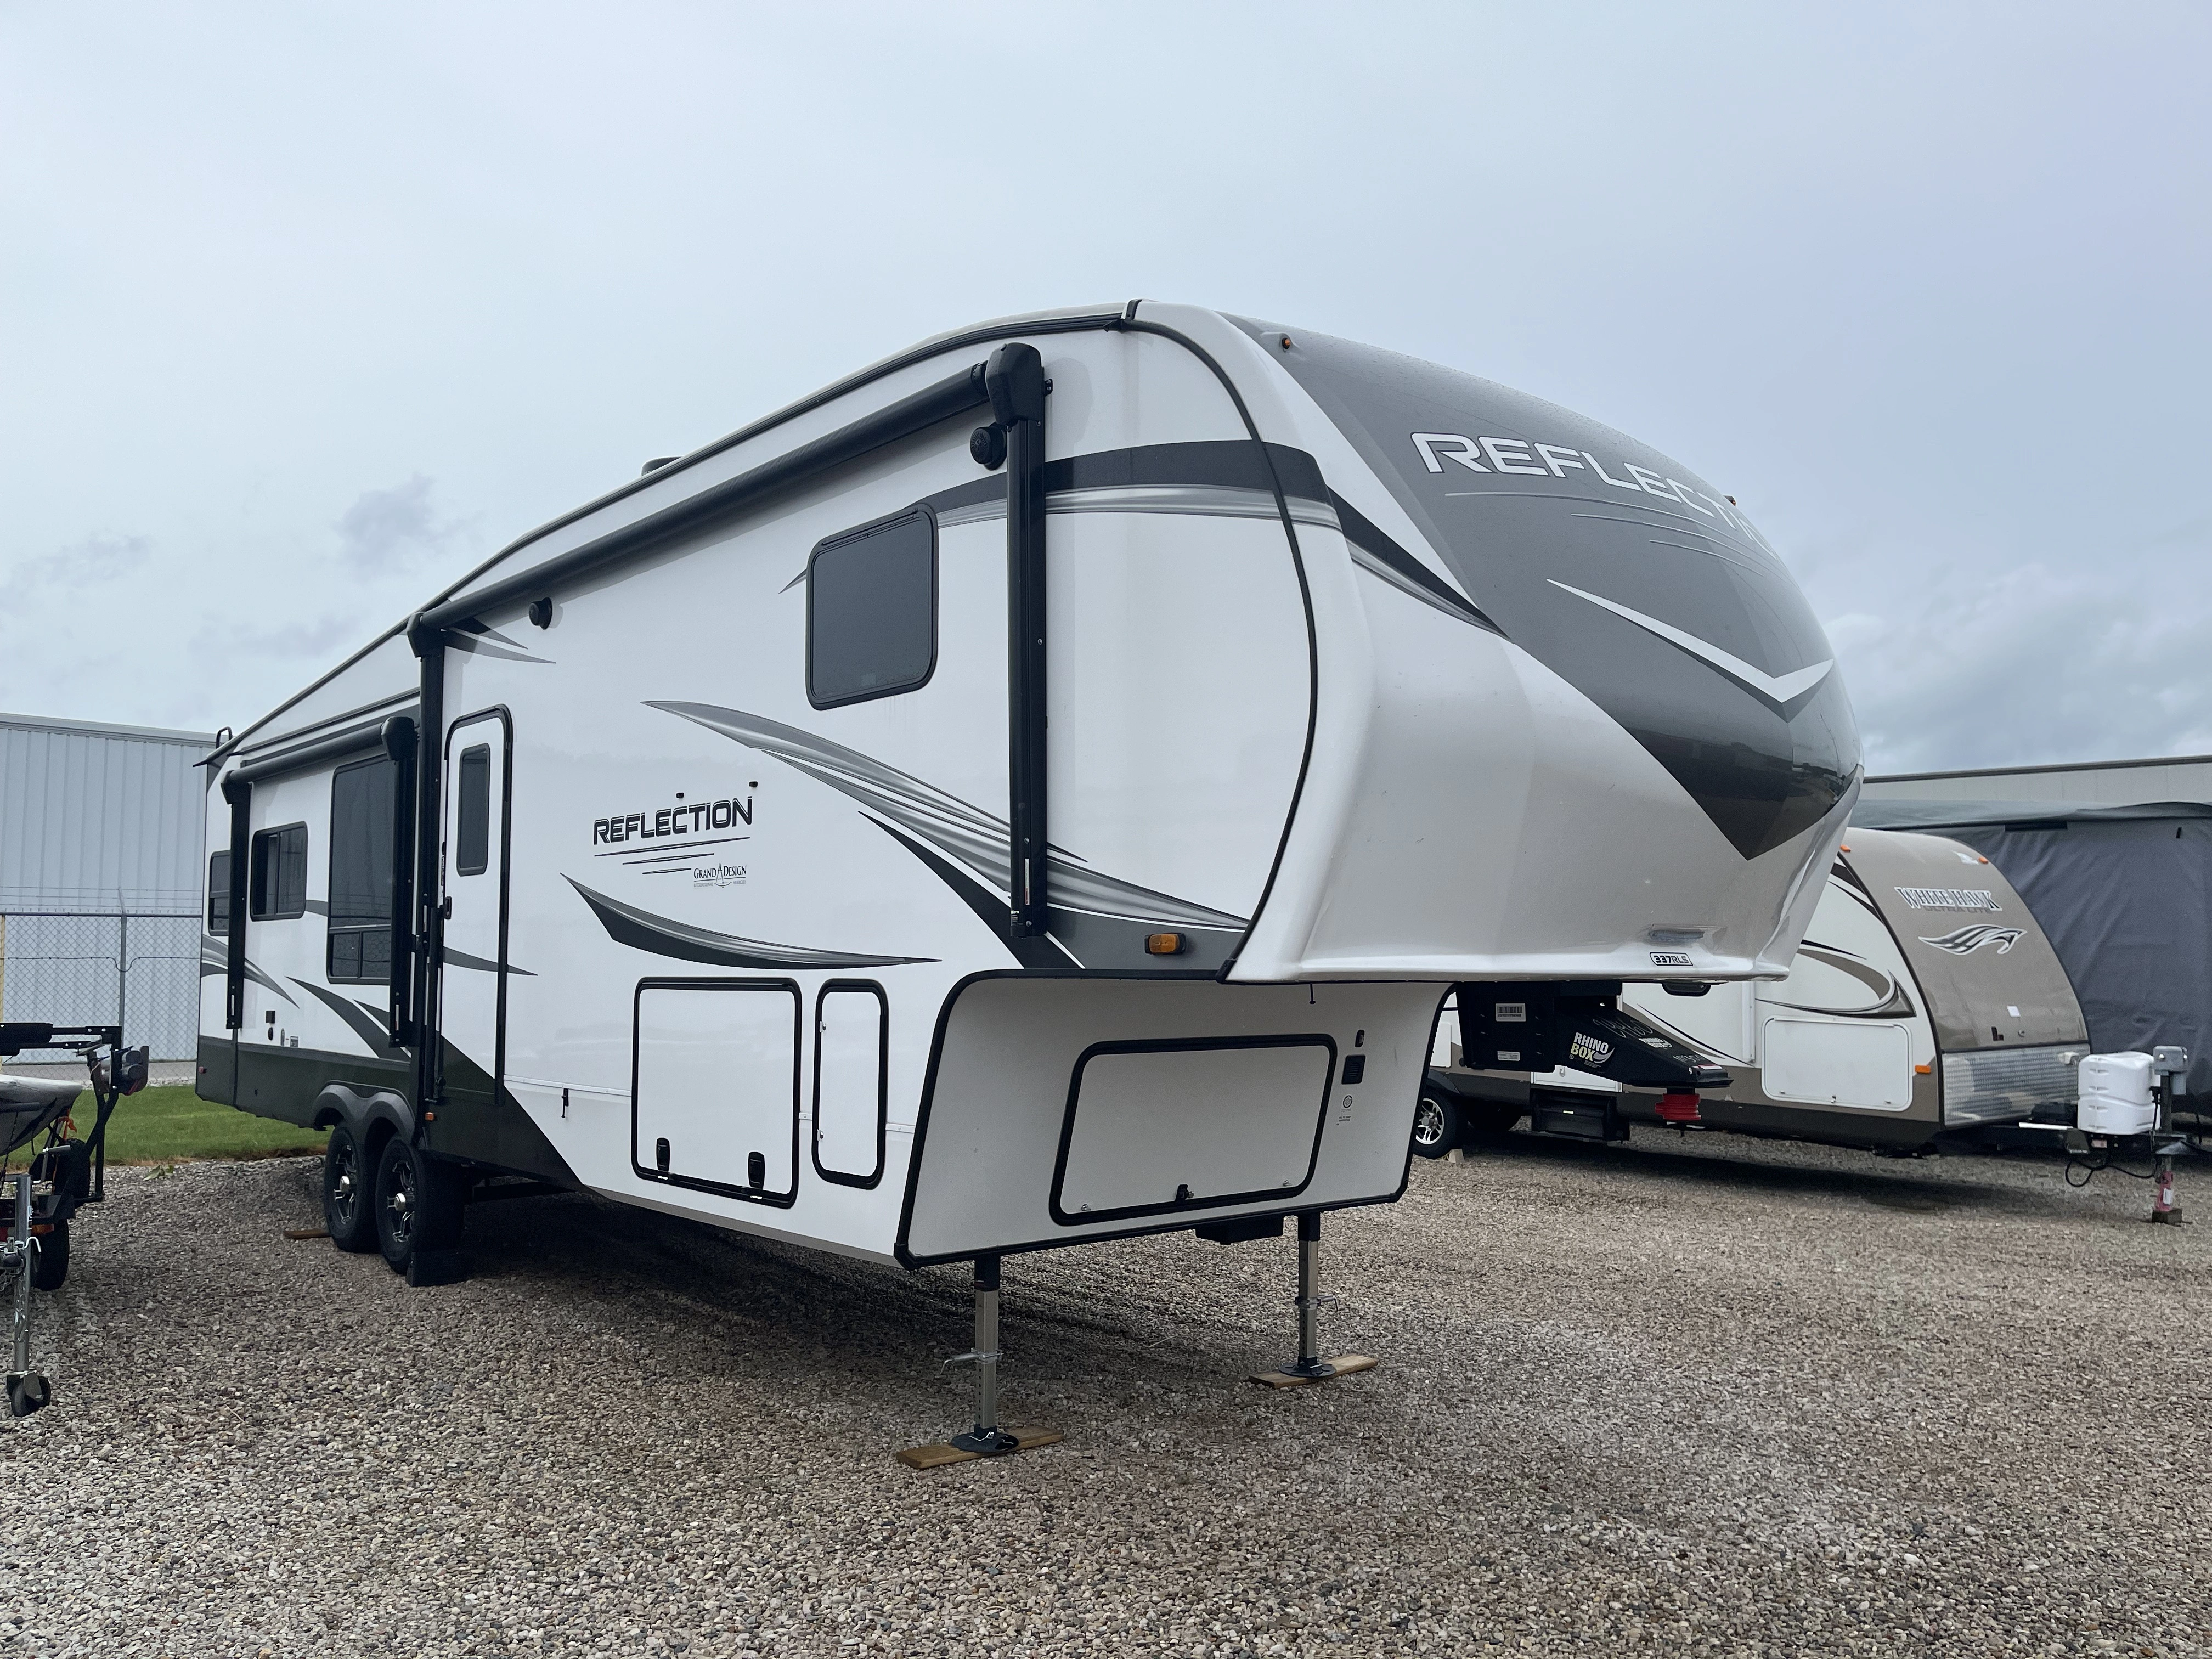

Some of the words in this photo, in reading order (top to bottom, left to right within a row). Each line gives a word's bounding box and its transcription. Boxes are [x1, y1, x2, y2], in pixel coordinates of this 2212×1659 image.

[594, 796, 753, 845] REFLECTION
[693, 868, 716, 879] GRAND
[723, 865, 747, 877] DESIGN
[1894, 886, 1955, 909] WHITE
[1948, 888, 2002, 911] HAWK
[1654, 955, 1689, 963] 337RLS
[1570, 1042, 1595, 1062] BOX
[1573, 1032, 1609, 1054] RHINO
